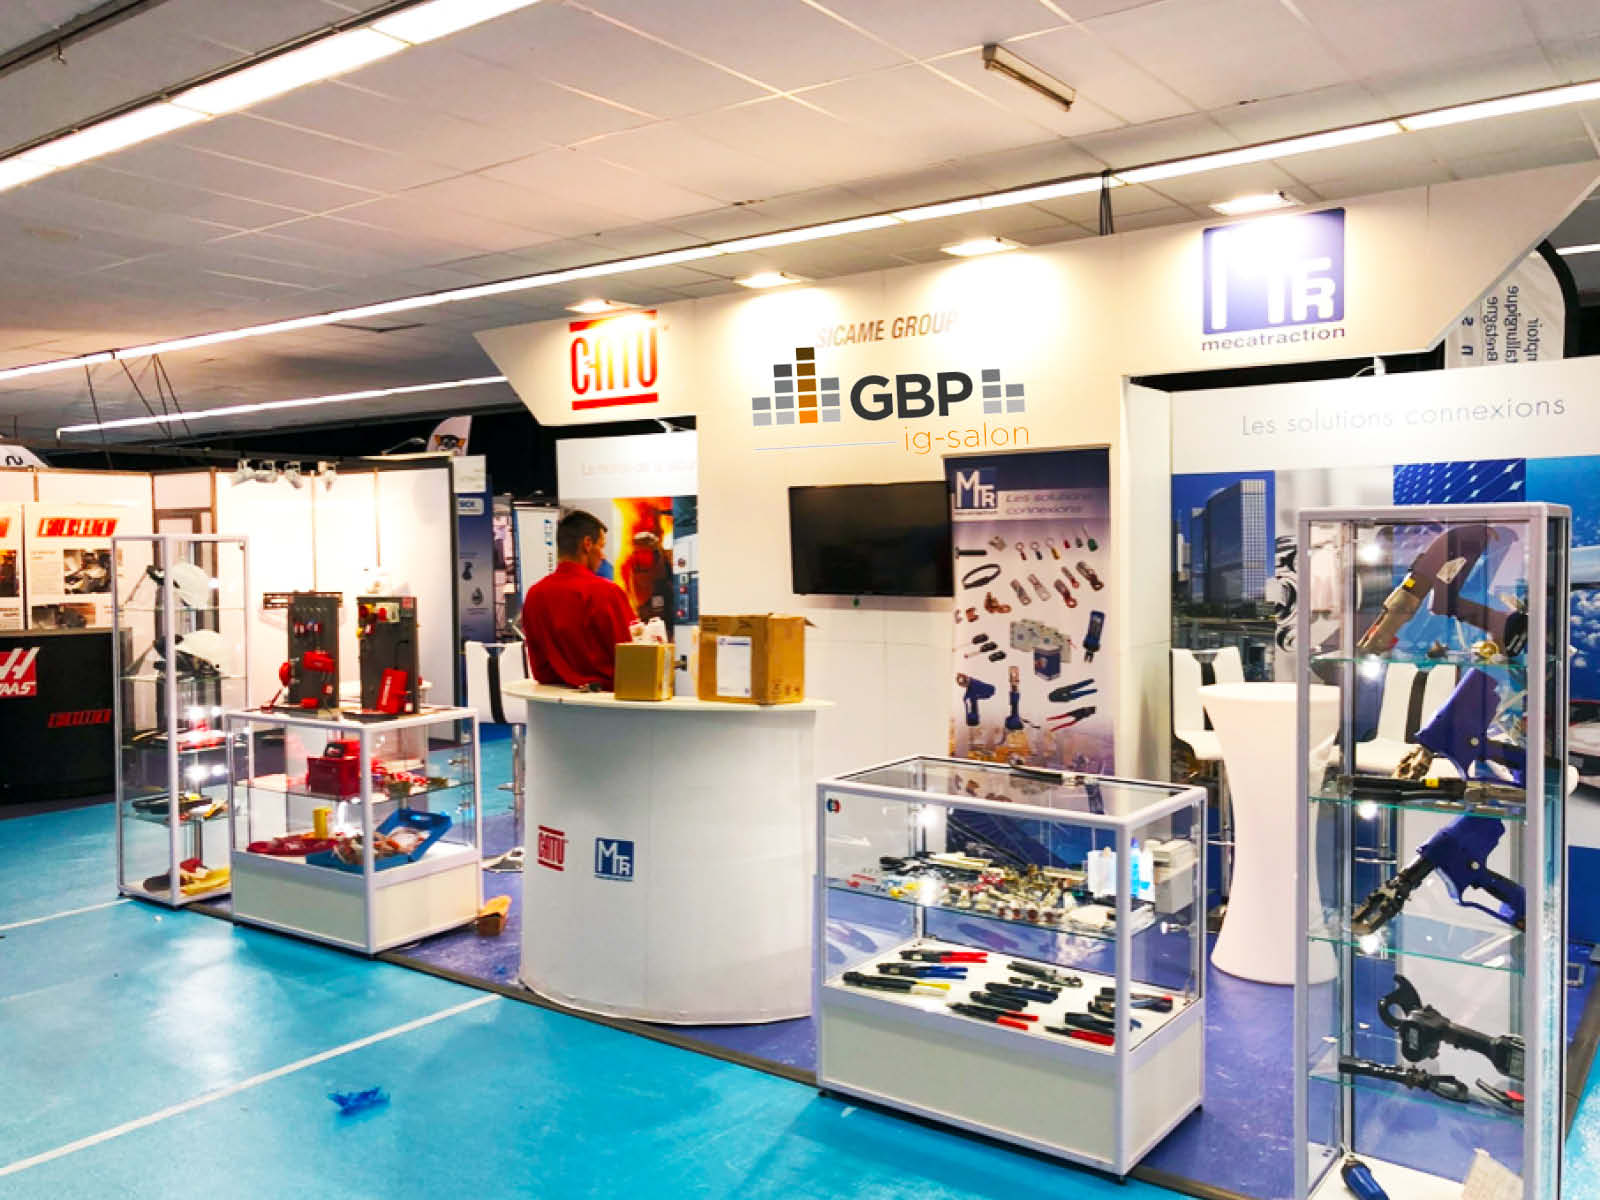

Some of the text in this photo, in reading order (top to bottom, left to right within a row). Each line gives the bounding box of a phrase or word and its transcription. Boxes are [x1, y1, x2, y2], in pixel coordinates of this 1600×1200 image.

[815, 310, 960, 348] SICAME GROUP
[1201, 327, 1346, 353] mecatraction
[1242, 397, 1566, 437] Les solutions connexions
